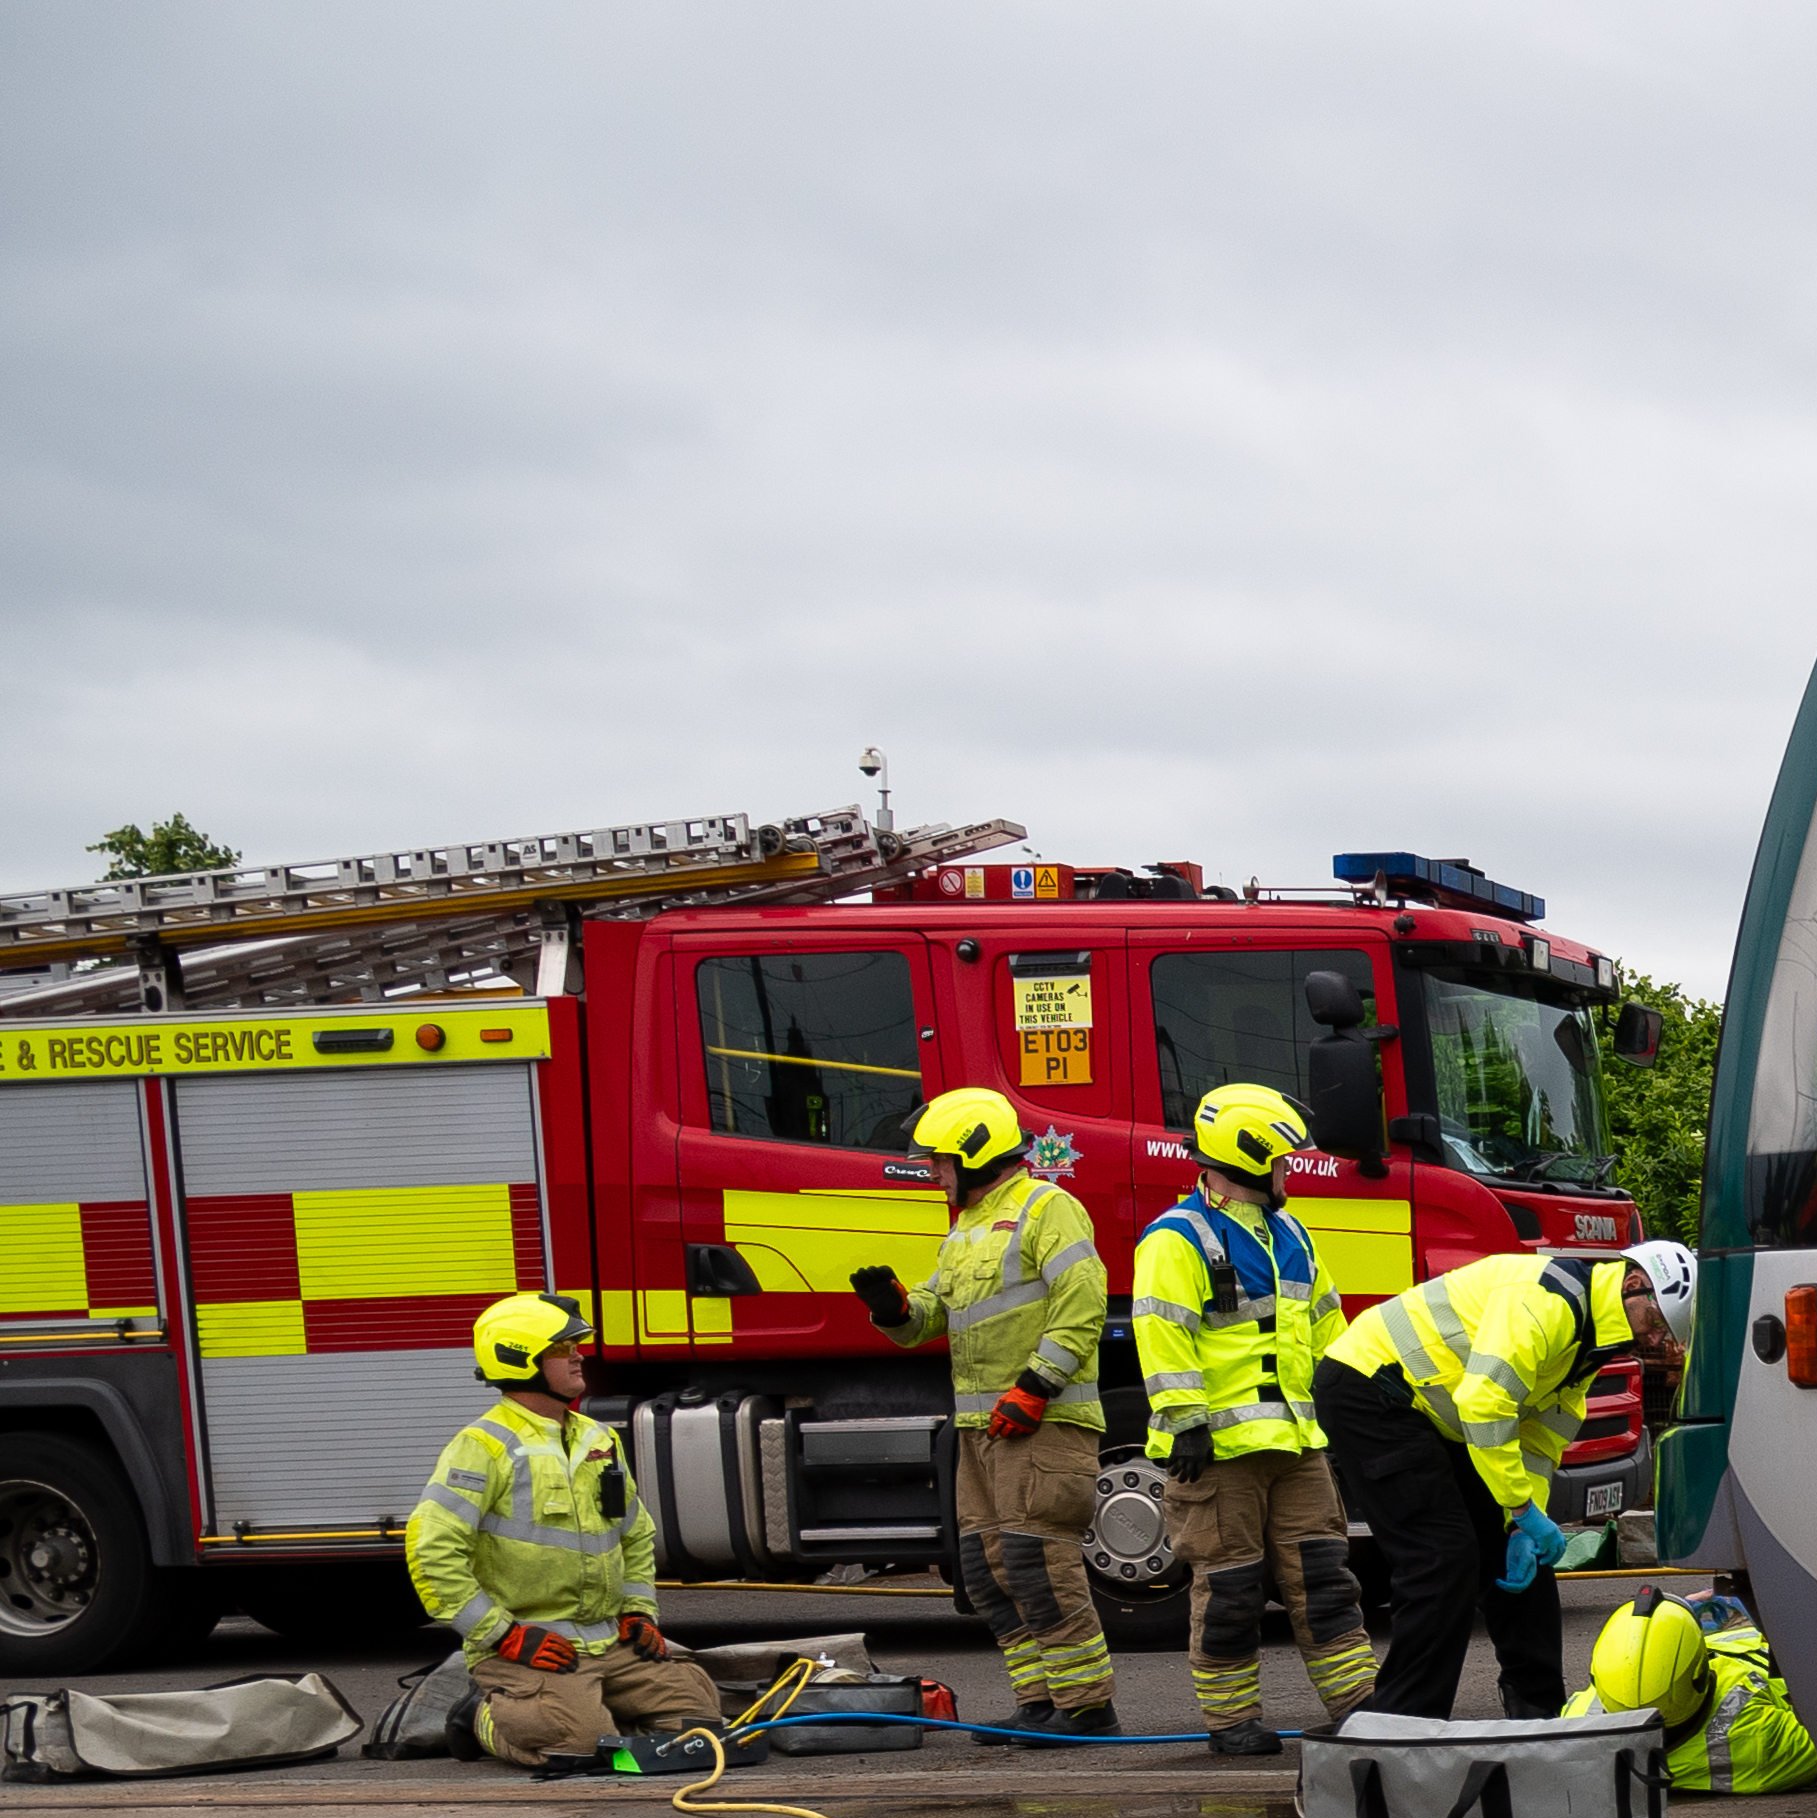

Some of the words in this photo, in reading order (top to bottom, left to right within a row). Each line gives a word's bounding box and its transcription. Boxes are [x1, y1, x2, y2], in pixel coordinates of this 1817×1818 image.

[1033, 982, 1055, 992] CCTV
[1025, 992, 1065, 1003] CAMERAS
[1025, 1003, 1034, 1013] IN
[1037, 1003, 1052, 1013] USE
[1054, 1002, 1066, 1012] ON
[1019, 1014, 1038, 1024] THIS
[1040, 1013, 1074, 1023] VEHICLE
[1024, 1029, 1088, 1054] ET03
[18, 1040, 37, 1070] &
[48, 1034, 163, 1069] RESCUE
[174, 1029, 293, 1064] SERVICE
[1574, 1214, 1617, 1241] SCANIA
